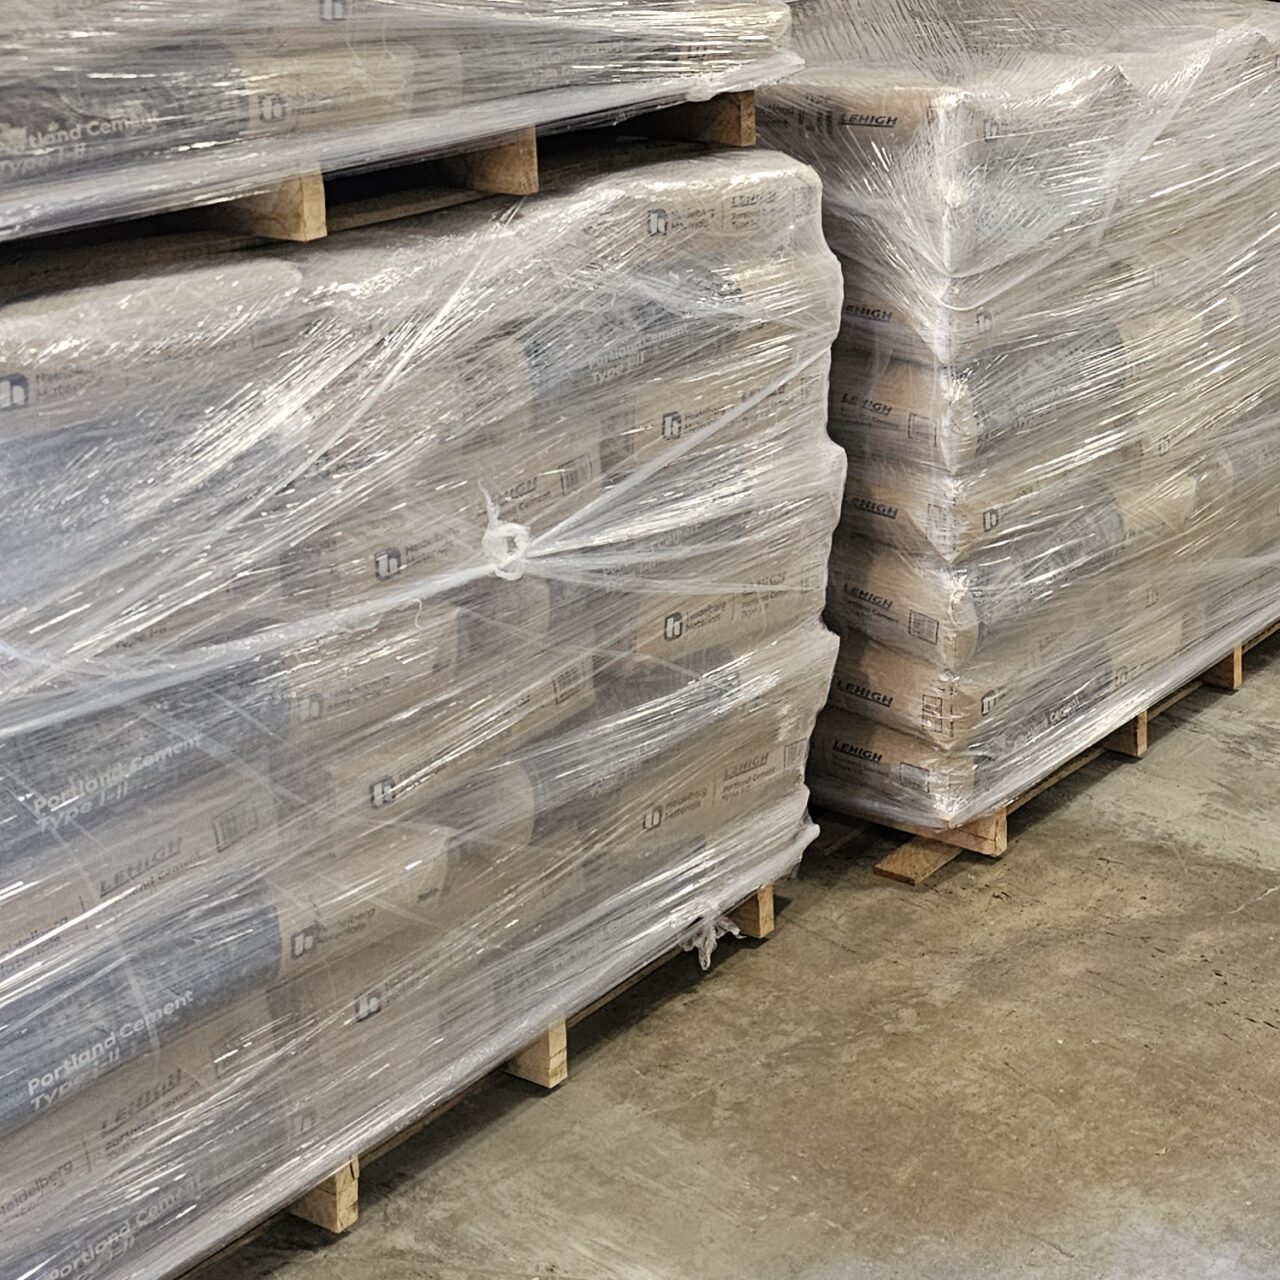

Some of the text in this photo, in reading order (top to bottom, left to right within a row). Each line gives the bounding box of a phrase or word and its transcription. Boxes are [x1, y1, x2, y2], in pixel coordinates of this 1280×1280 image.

[838, 113, 898, 128] LEHIGH
[844, 304, 893, 322] EHIGH
[843, 583, 893, 610] LEHIGH
[836, 679, 894, 708] LEHIGH
[832, 739, 883, 764] LEHIGH
[36, 781, 129, 833] Type I-II
[28, 988, 195, 1097] Portland Cement
